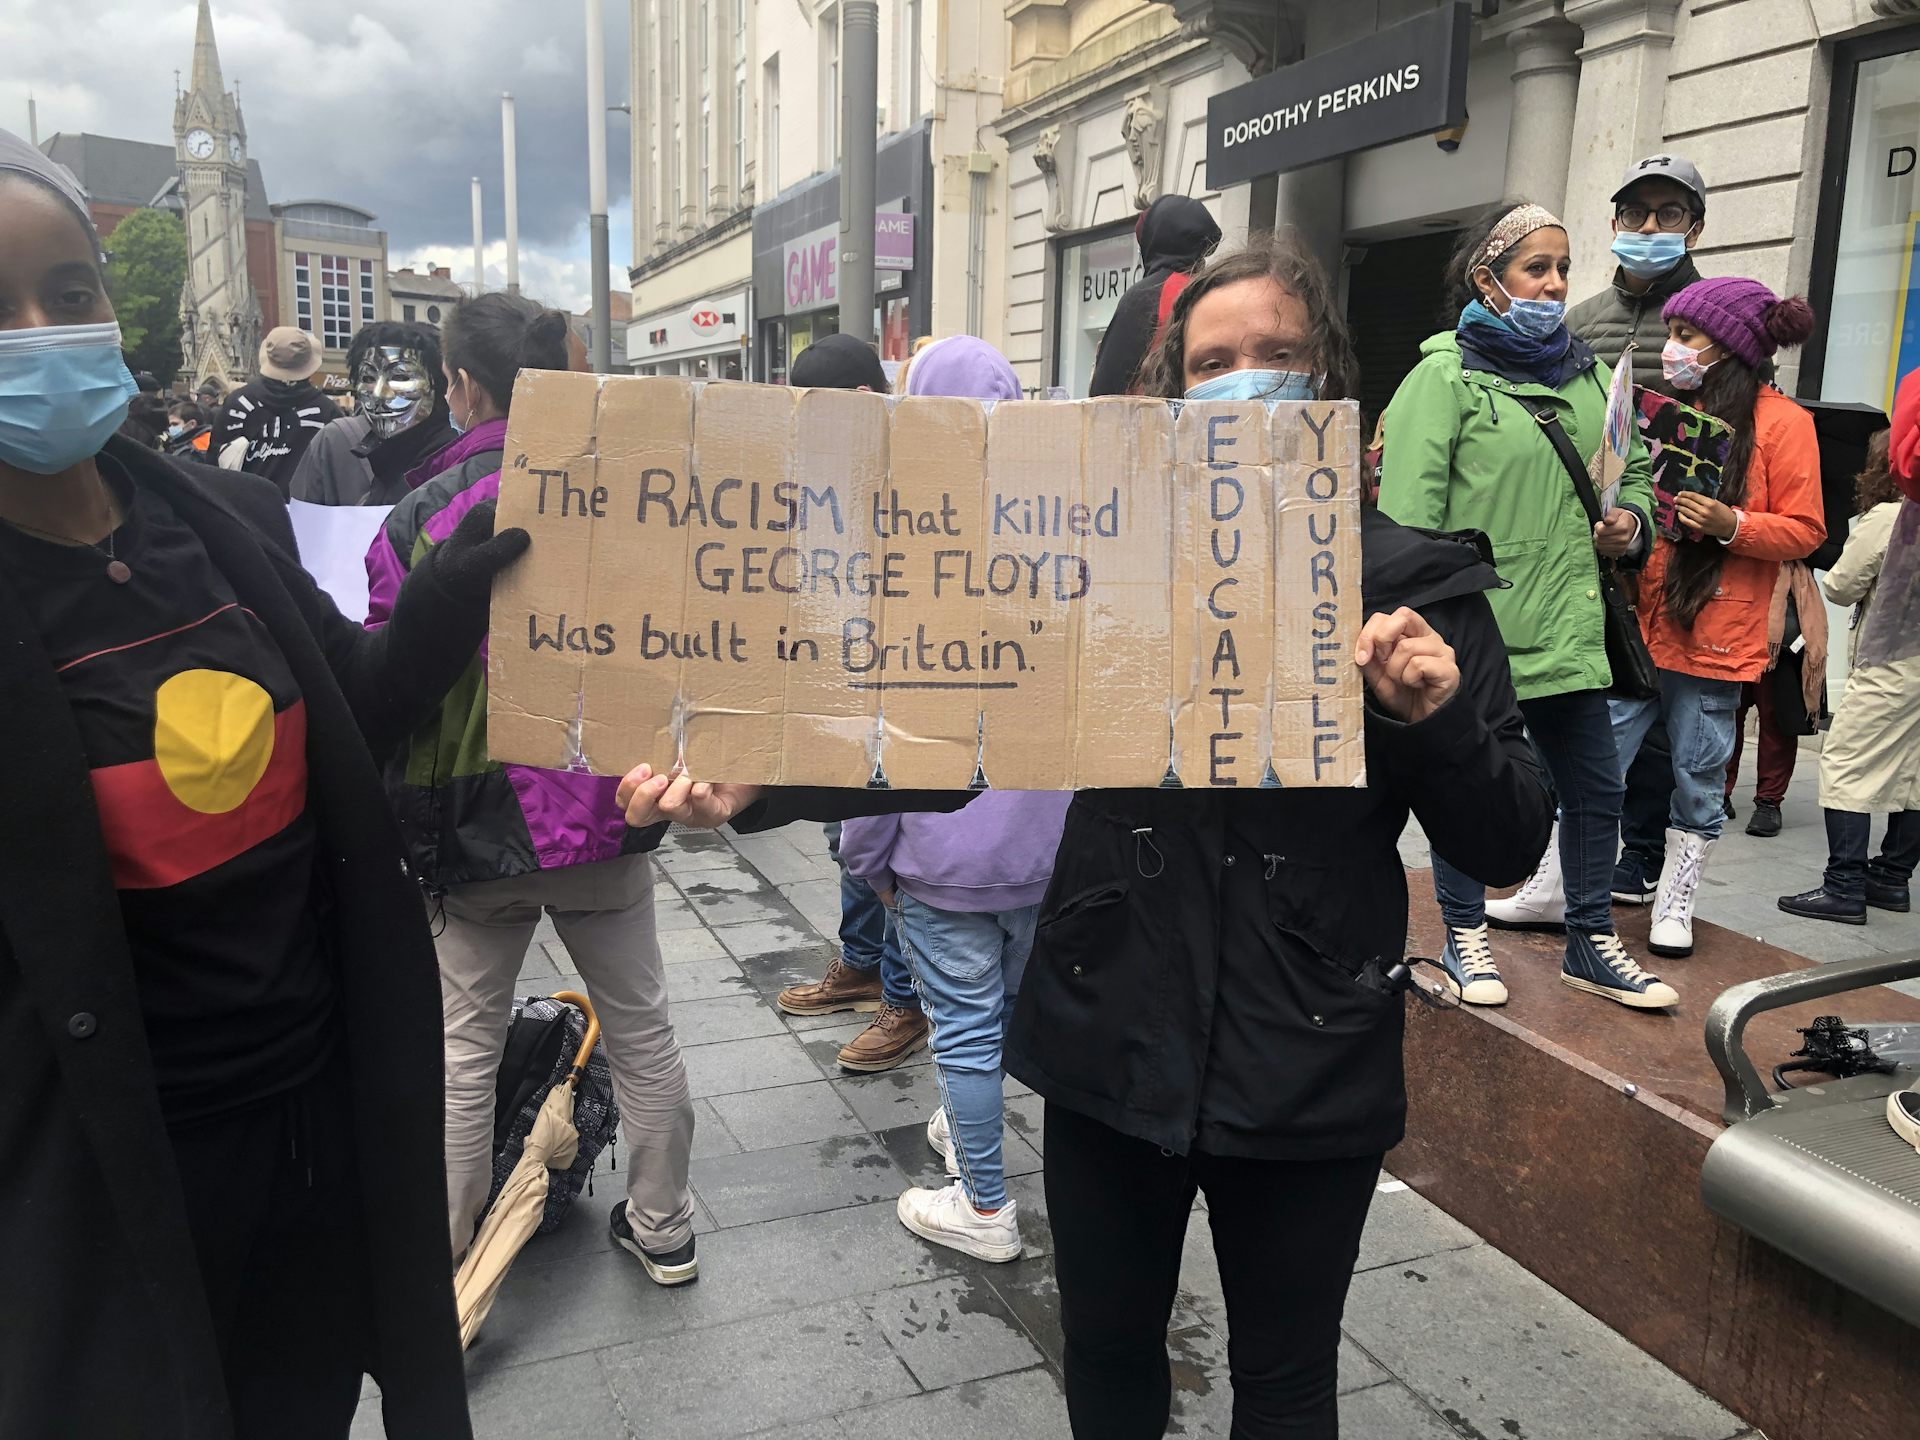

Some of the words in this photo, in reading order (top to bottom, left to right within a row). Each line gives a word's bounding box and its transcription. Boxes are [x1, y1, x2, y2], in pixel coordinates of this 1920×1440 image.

[1224, 100, 1312, 148] DOROTHY
[1318, 64, 1420, 118] PERKINS
[875, 220, 910, 235] AME
[786, 238, 836, 307] GAME
[1083, 264, 1144, 302] BURT
[323, 374, 350, 388] Pizz
[637, 468, 844, 536] RACISM
[873, 489, 961, 538] that
[694, 542, 910, 598] GEORGE
[933, 550, 1091, 601] FLOYD
[1207, 414, 1245, 786] EDUCATE
[1301, 408, 1341, 782] YOURSELF
[528, 613, 616, 656] Was
[640, 613, 747, 661] built
[777, 626, 819, 663] in
